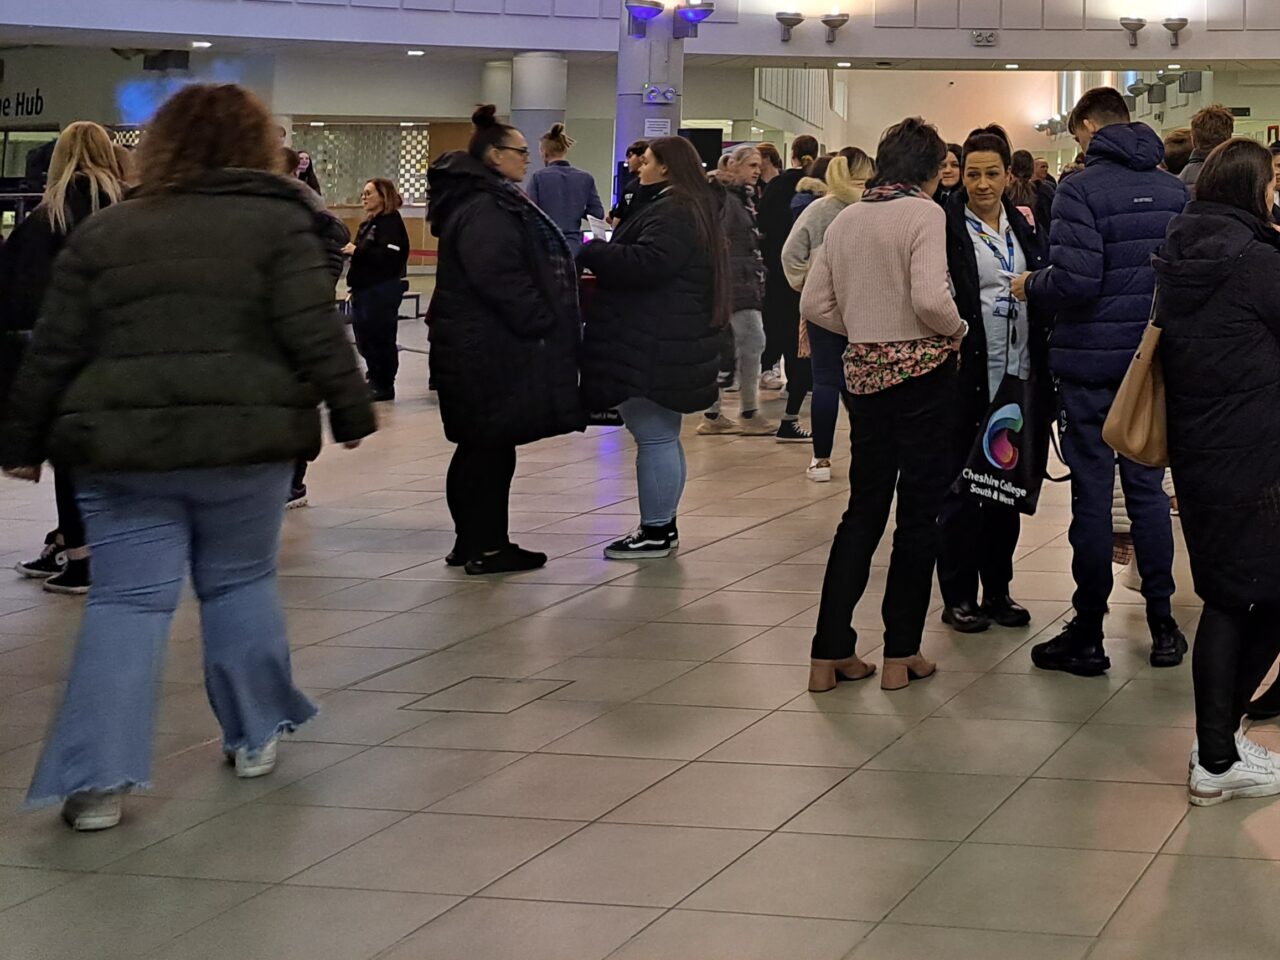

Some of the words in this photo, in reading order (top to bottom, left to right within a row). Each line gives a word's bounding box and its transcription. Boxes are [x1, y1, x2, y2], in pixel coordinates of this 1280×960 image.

[15, 88, 44, 117] Hub
[962, 468, 999, 488] Cheshire
[1000, 479, 1027, 498] College
[970, 483, 992, 498] South
[992, 490, 998, 501] &
[999, 492, 1015, 506] West
